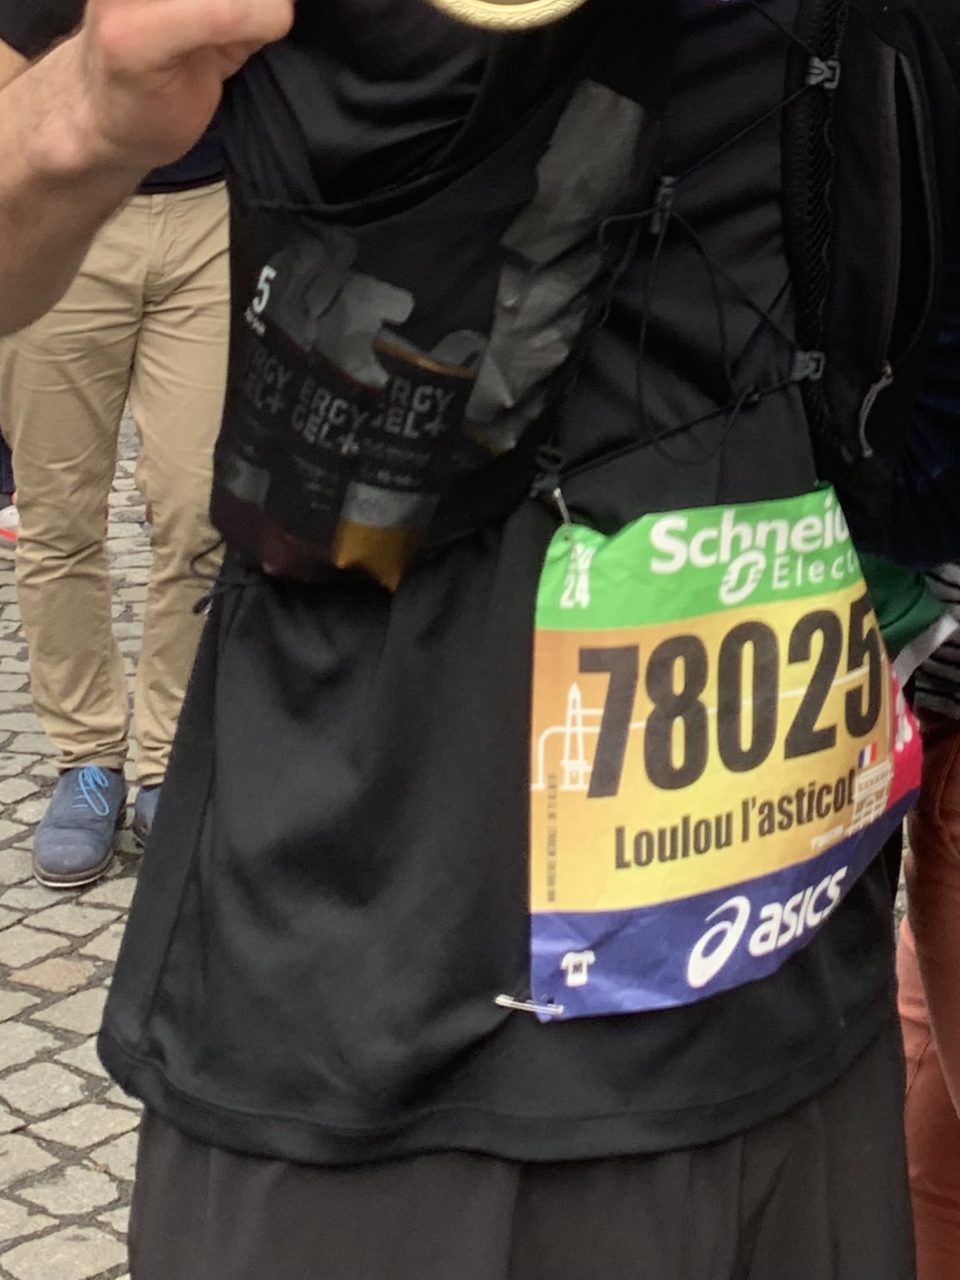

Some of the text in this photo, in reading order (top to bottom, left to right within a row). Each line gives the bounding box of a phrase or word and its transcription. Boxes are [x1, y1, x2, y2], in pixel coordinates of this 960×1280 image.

[578, 592, 883, 799] 78025
[614, 810, 734, 871] Loulou
[748, 865, 848, 957] asics
